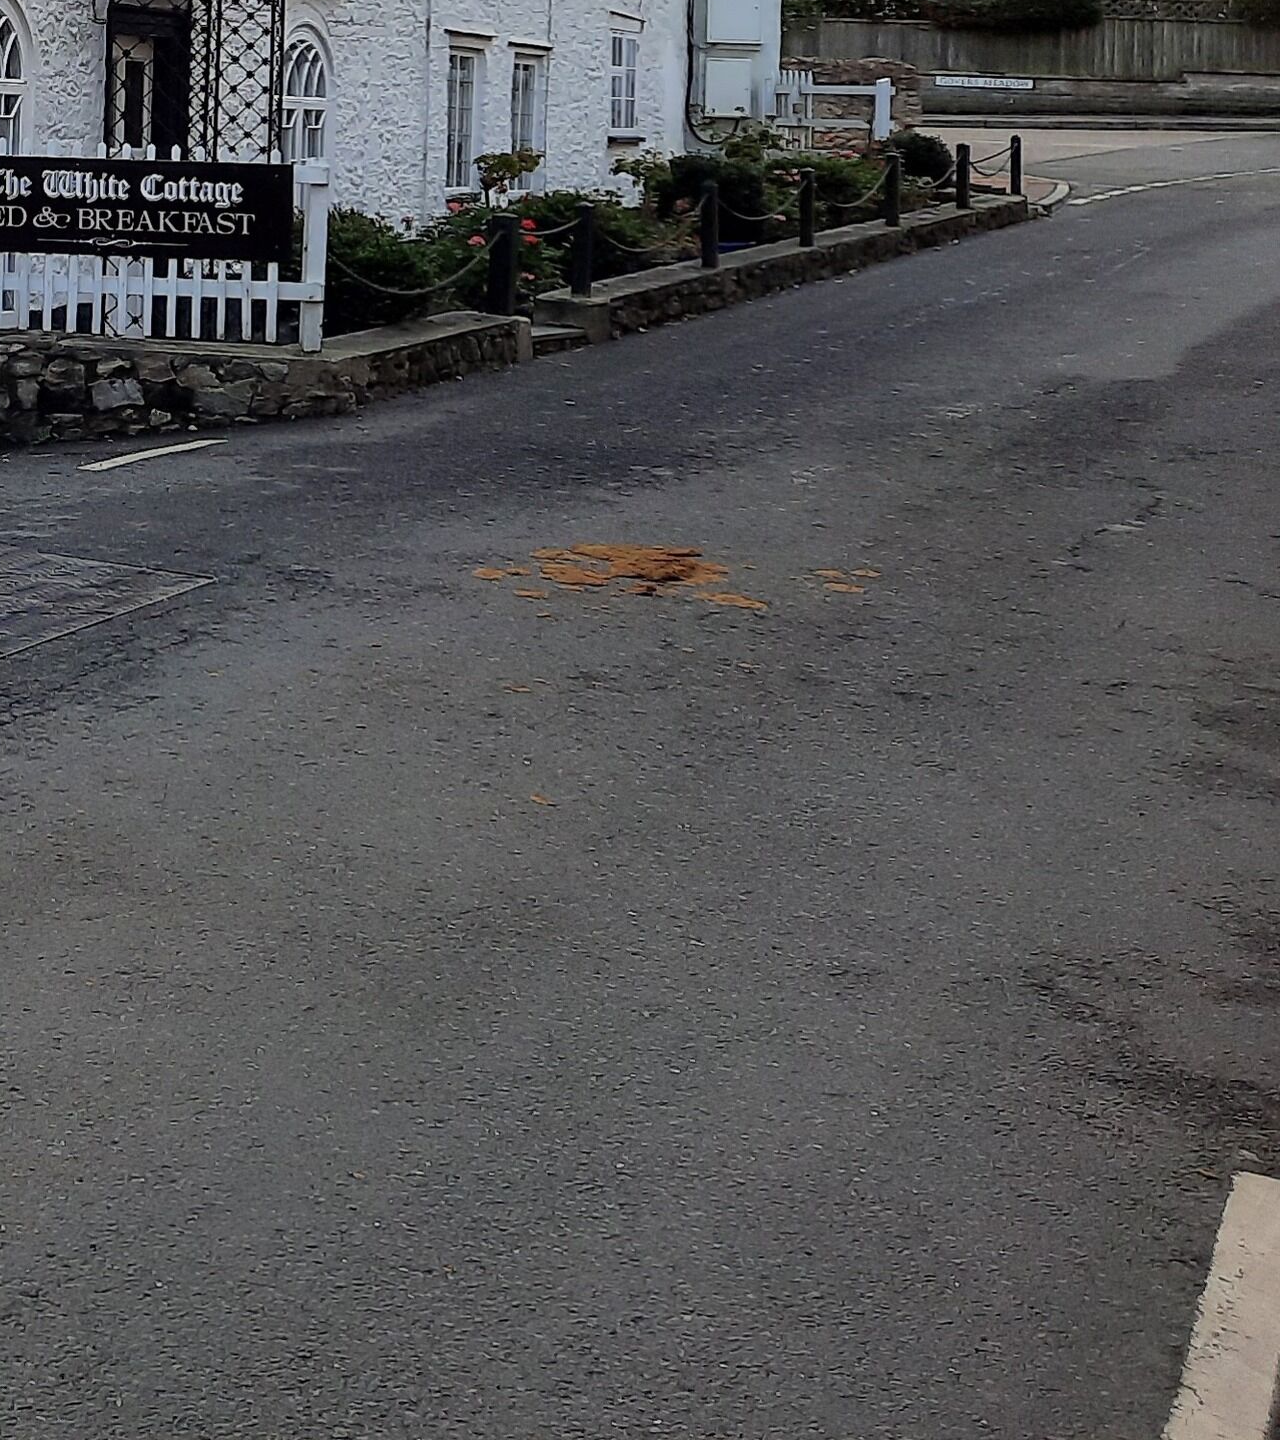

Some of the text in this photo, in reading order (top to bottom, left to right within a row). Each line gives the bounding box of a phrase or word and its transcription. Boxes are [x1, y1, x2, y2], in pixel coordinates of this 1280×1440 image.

[41, 169, 131, 203] White
[140, 173, 244, 208] Cottage
[32, 206, 71, 229] &
[76, 208, 256, 236] BREAKFAST
